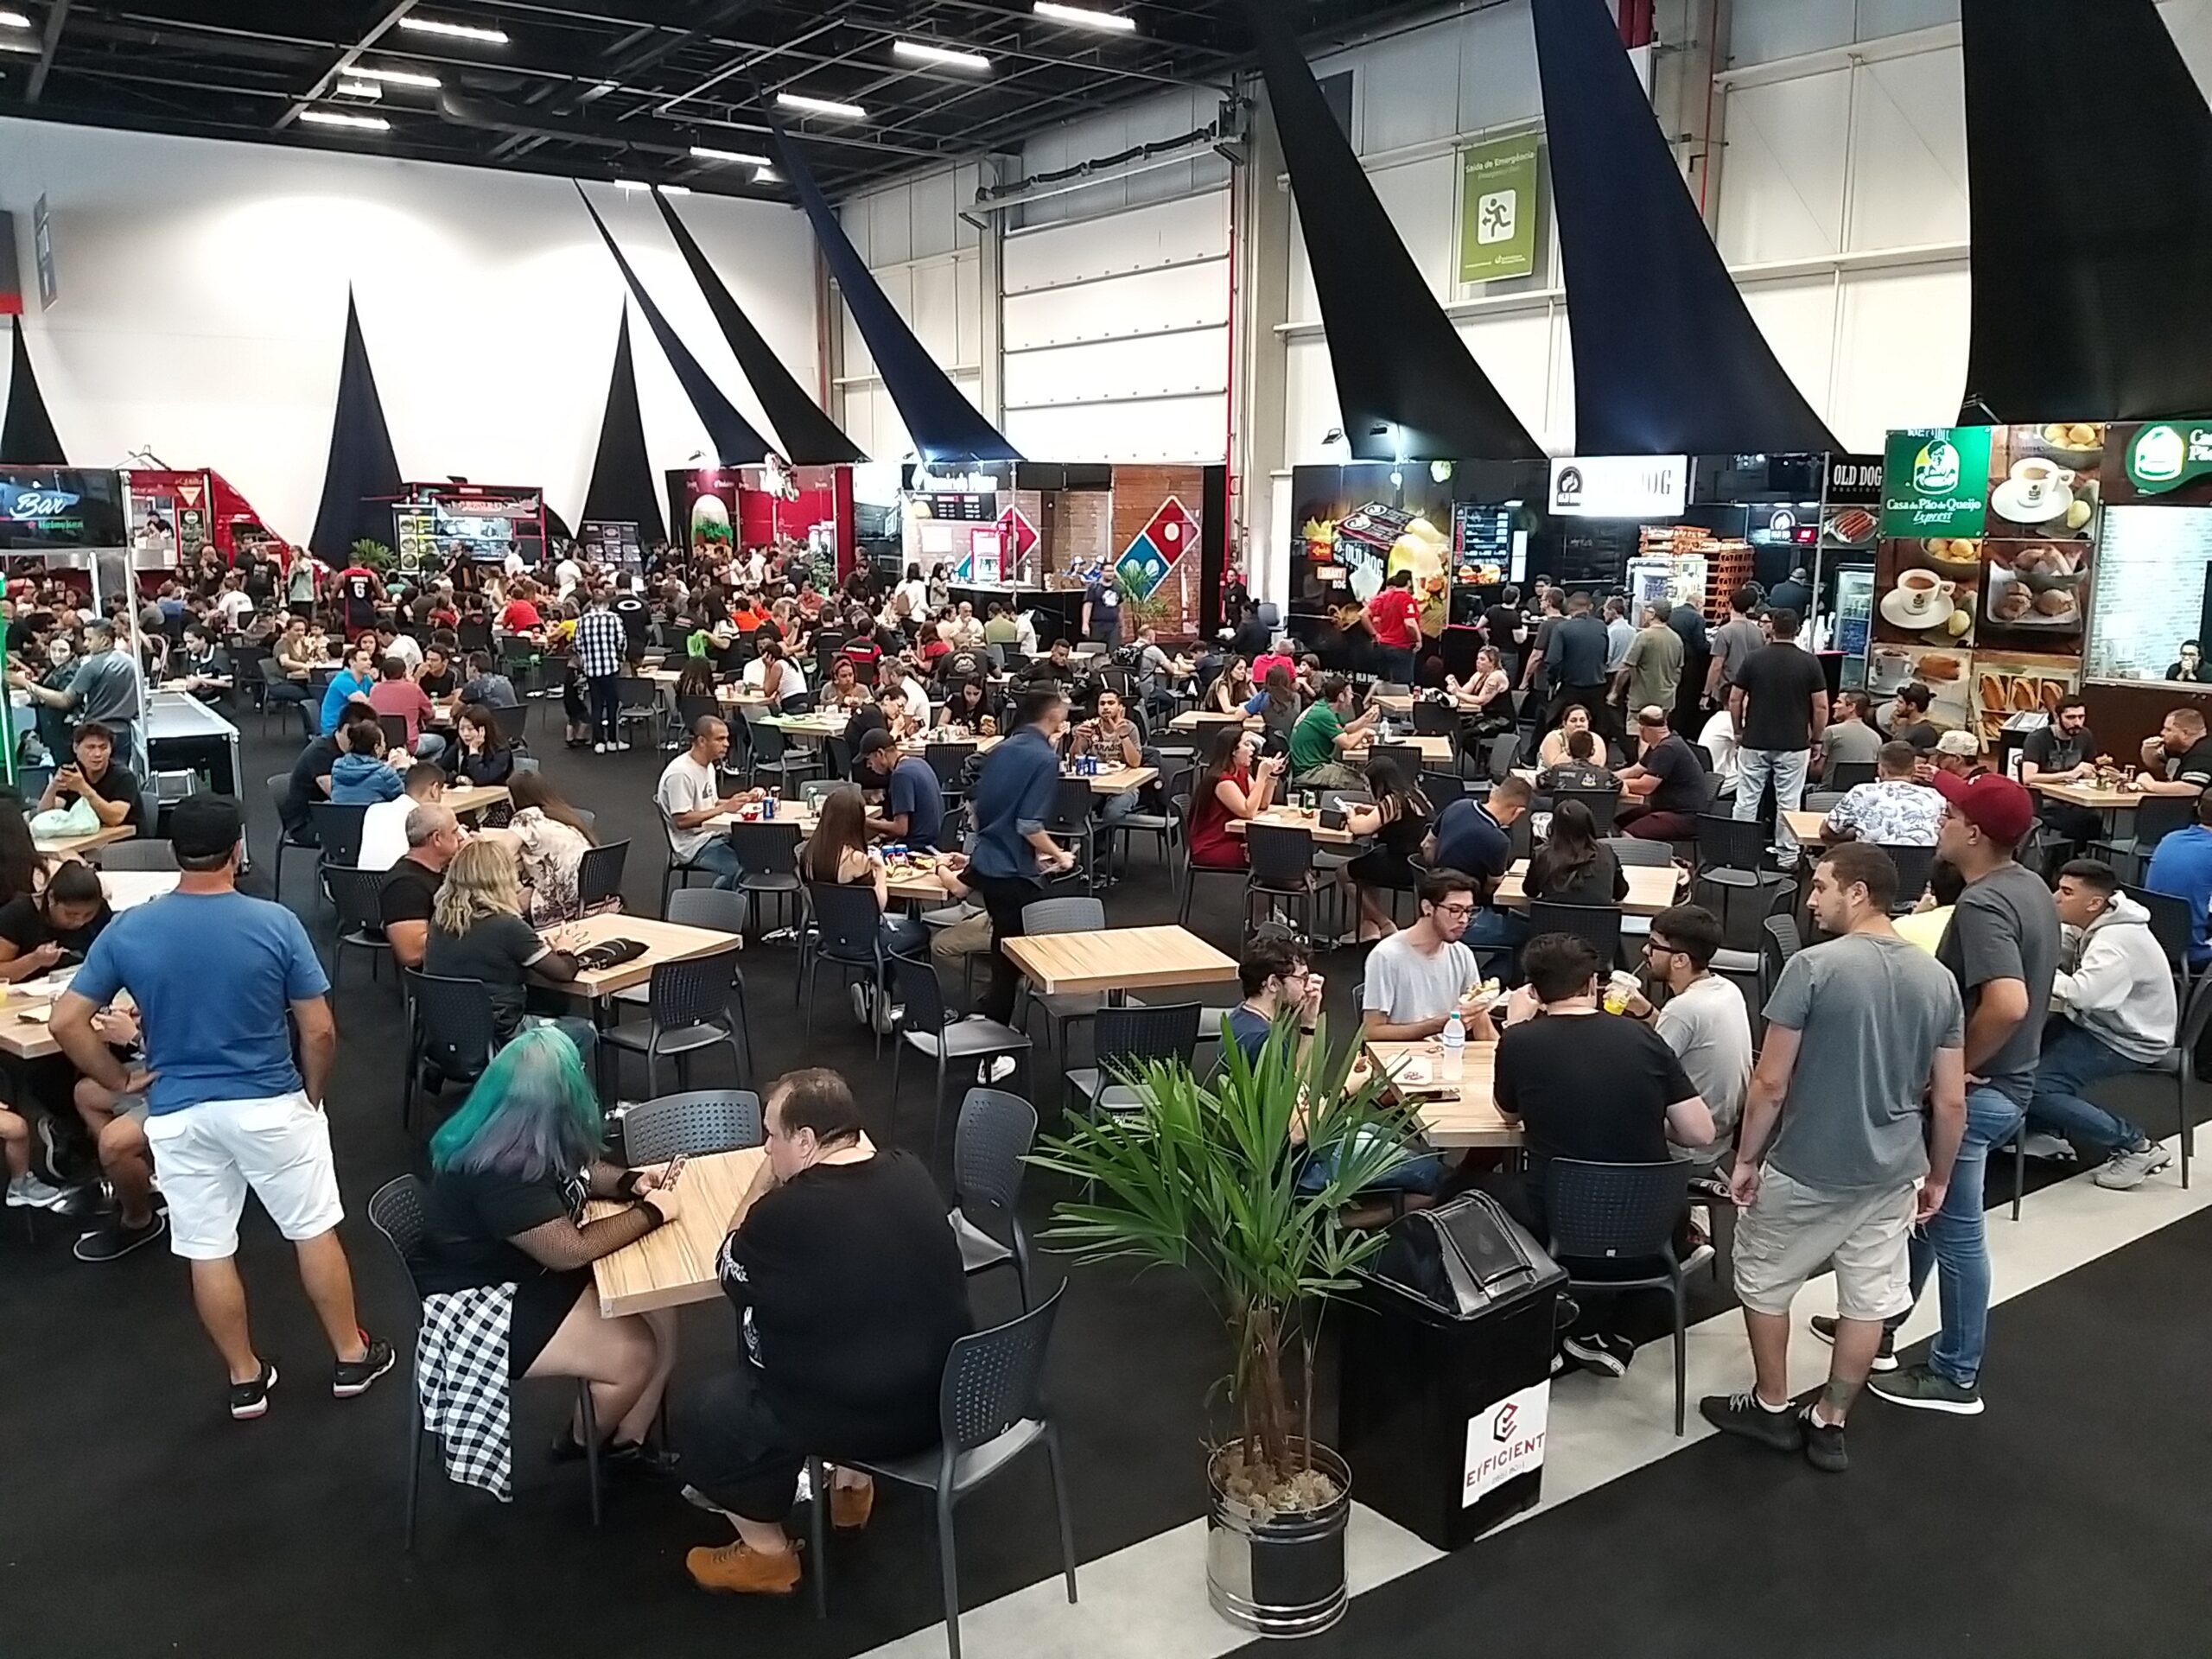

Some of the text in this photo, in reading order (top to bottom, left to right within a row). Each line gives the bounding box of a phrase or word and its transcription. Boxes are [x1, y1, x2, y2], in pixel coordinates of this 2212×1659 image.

[1834, 464, 1883, 486] OLD DOG
[10, 493, 67, 518] Bar
[1886, 499, 1909, 510] Casa
[1946, 498, 1982, 512] Queijo
[1345, 543, 1363, 566] OLD
[354, 582, 365, 599] 6
[1332, 580, 1346, 589] DOG
